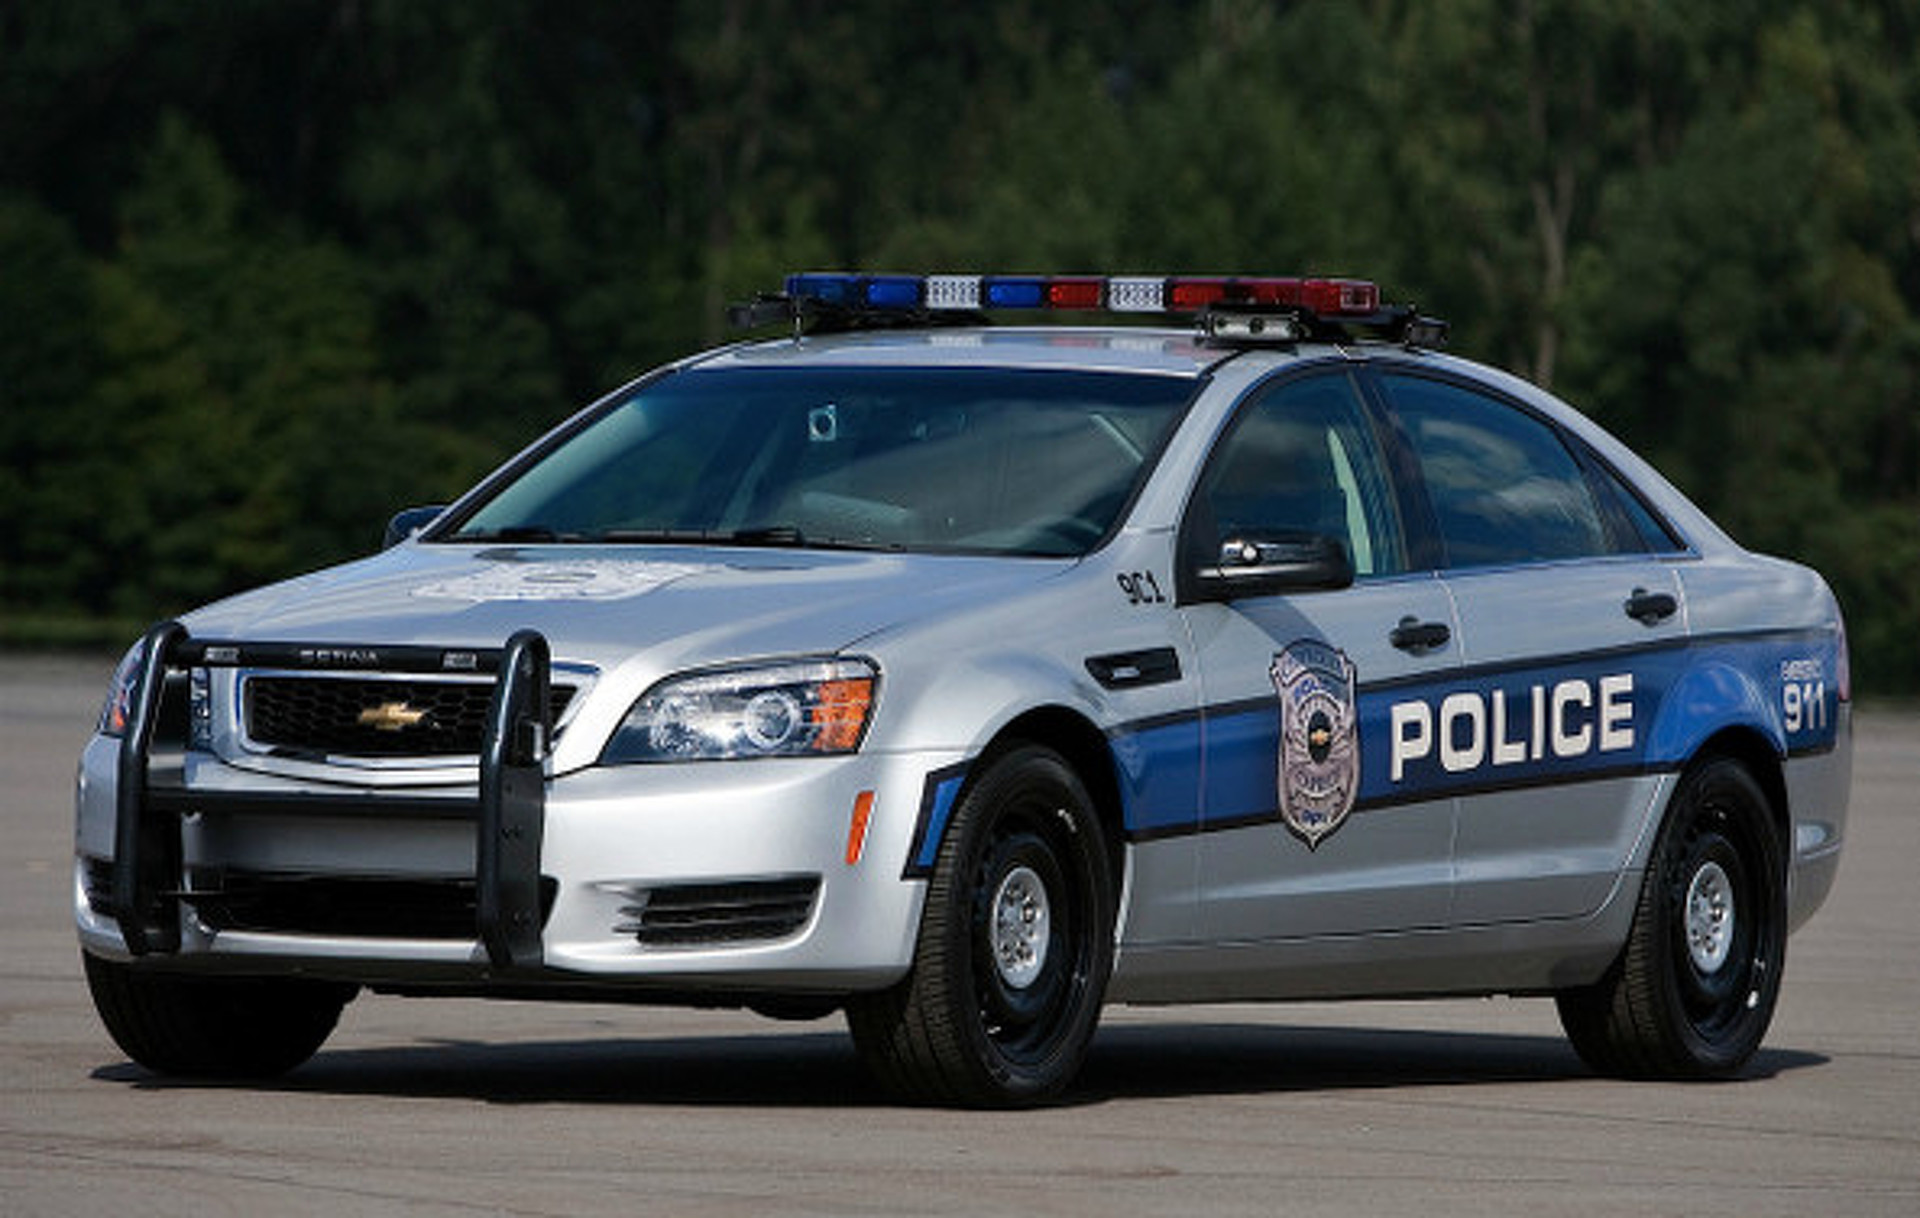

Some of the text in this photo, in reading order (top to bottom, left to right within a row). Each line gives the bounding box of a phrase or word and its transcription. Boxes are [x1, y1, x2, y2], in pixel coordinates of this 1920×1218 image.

[1117, 570, 1166, 605] 9C1
[1390, 673, 1635, 783] POLICE
[1783, 682, 1827, 732] 911
